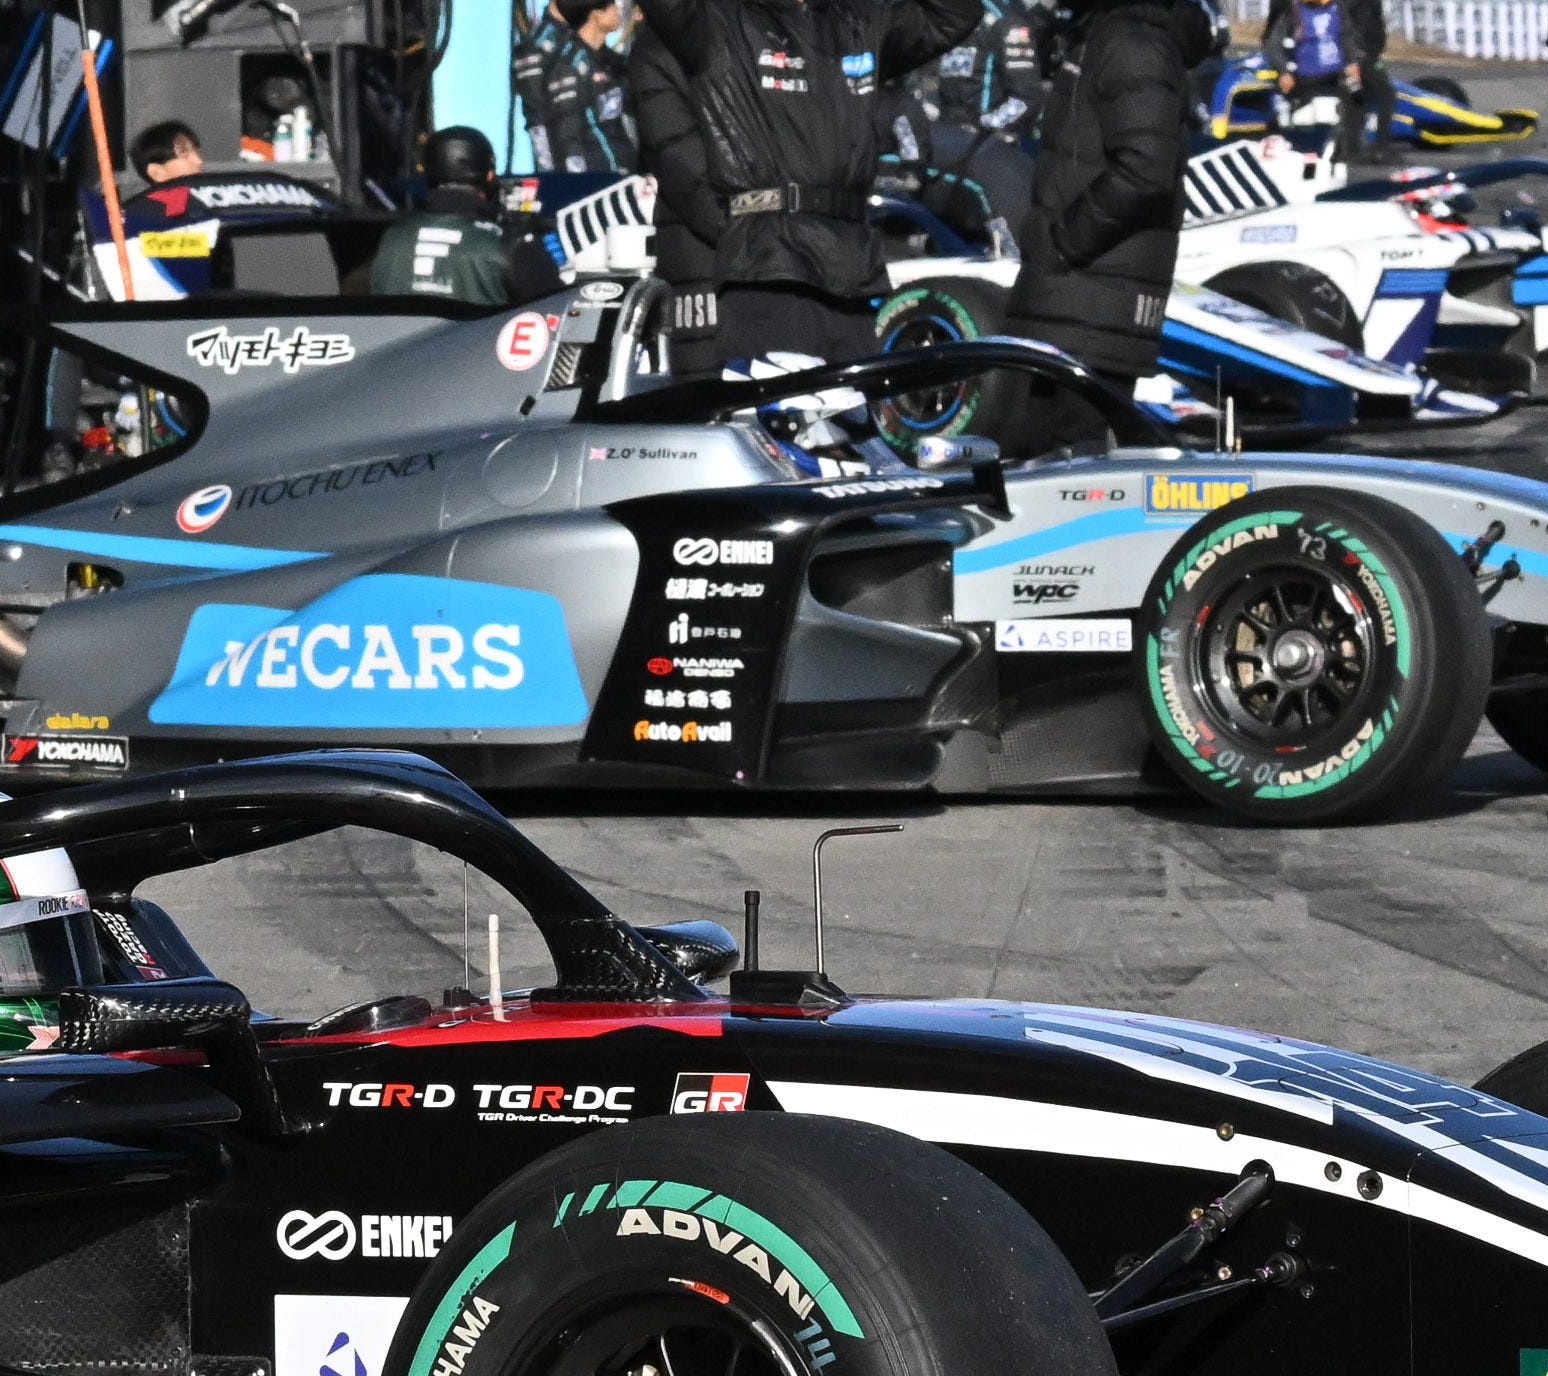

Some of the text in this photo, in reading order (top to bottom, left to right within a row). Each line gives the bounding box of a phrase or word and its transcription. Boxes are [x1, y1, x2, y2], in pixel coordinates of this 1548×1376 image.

[638, 447, 697, 460] Sullivan
[235, 449, 444, 510] ITOCHU ENEX
[1060, 488, 1126, 502] TGR-D
[719, 539, 774, 565] ENKEI
[1182, 523, 1279, 592] ADVAN
[1357, 563, 1397, 646] YOKOHAMA
[1036, 628, 1130, 647] ASPIRE
[205, 624, 525, 692] WECARS
[672, 657, 745, 669] NANIWA
[1159, 664, 1201, 746] YOKOHAMA
[37, 740, 125, 764] YOKOHAMA
[1278, 717, 1374, 787] ADVAN
[38, 899, 69, 916] ROOKIE
[322, 1081, 636, 1112] TGR-D TGR-DC
[672, 1090, 746, 1113] GR
[477, 1112, 504, 1122] TGR
[505, 1112, 537, 1123] Driver
[539, 1113, 587, 1125] Challenge
[616, 1207, 816, 1320] ADVAN
